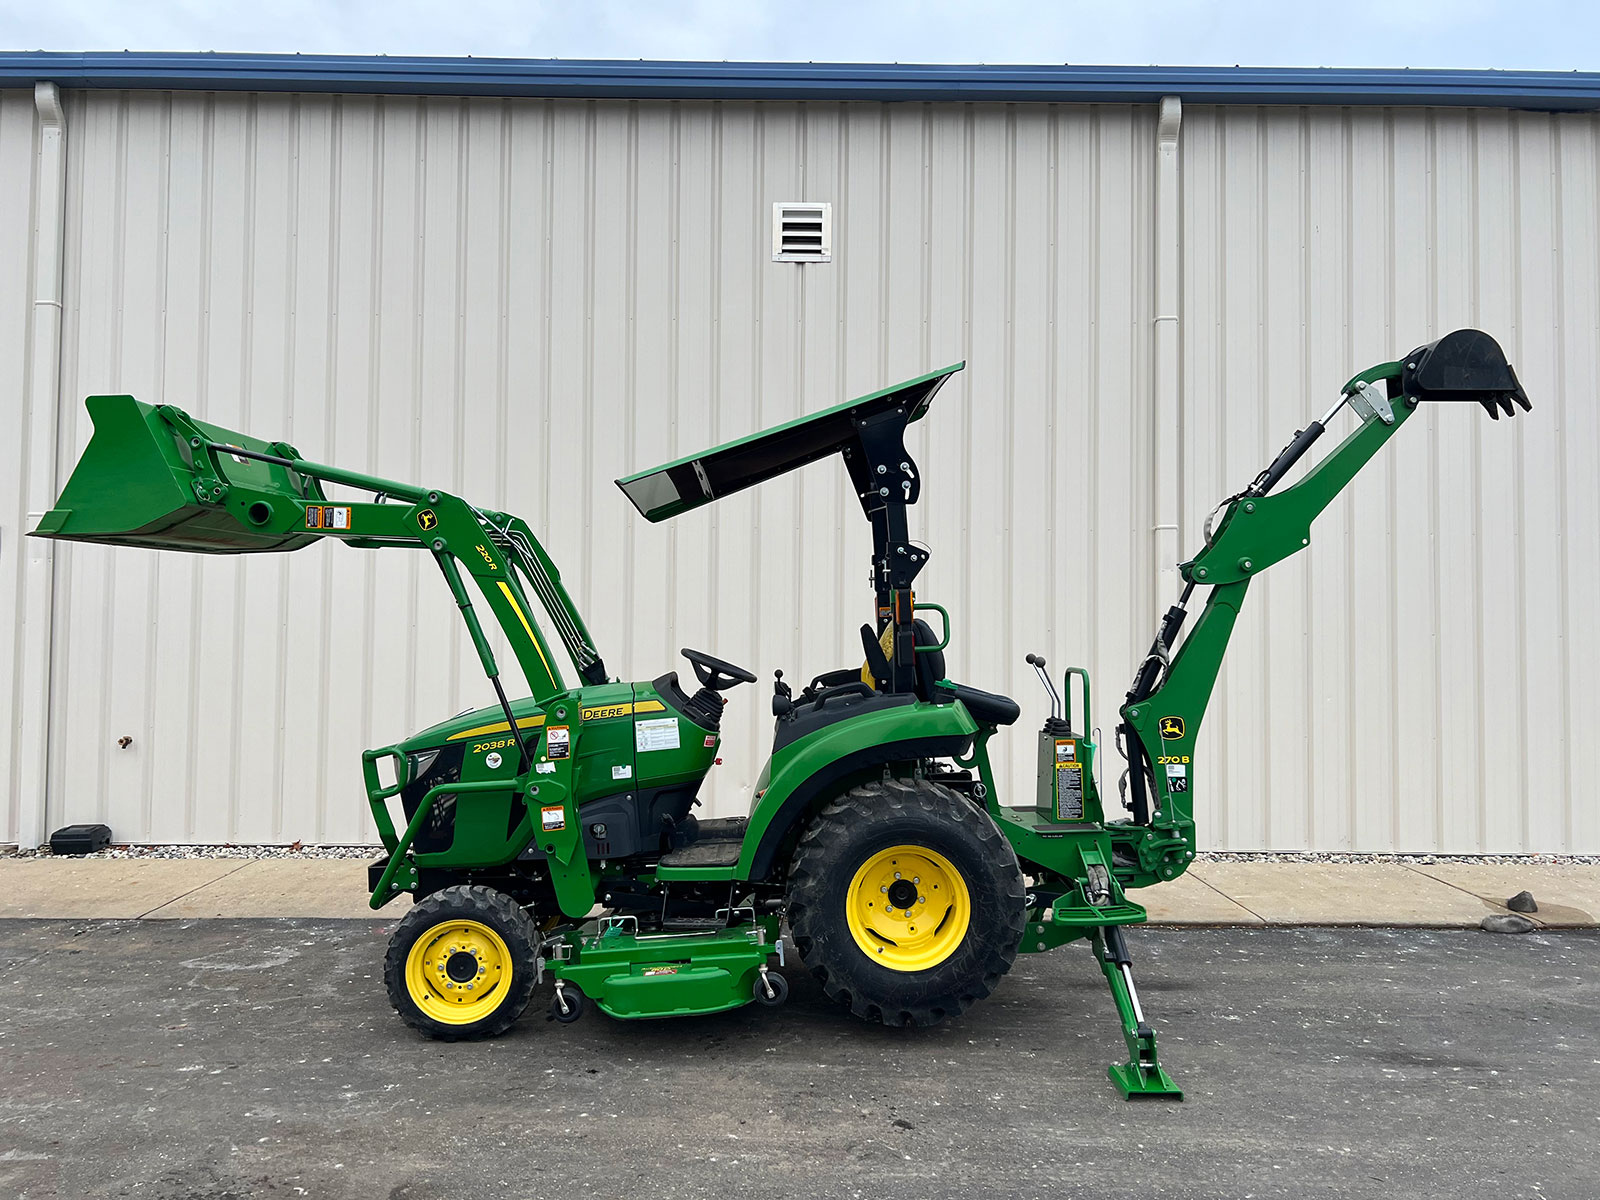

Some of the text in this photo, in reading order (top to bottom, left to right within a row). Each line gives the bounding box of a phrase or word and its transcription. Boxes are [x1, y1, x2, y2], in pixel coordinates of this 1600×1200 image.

[475, 544, 492, 562] 220
[583, 707, 624, 720] DEERE
[473, 738, 516, 753] 2038 R
[1157, 755, 1190, 764] 270 B
